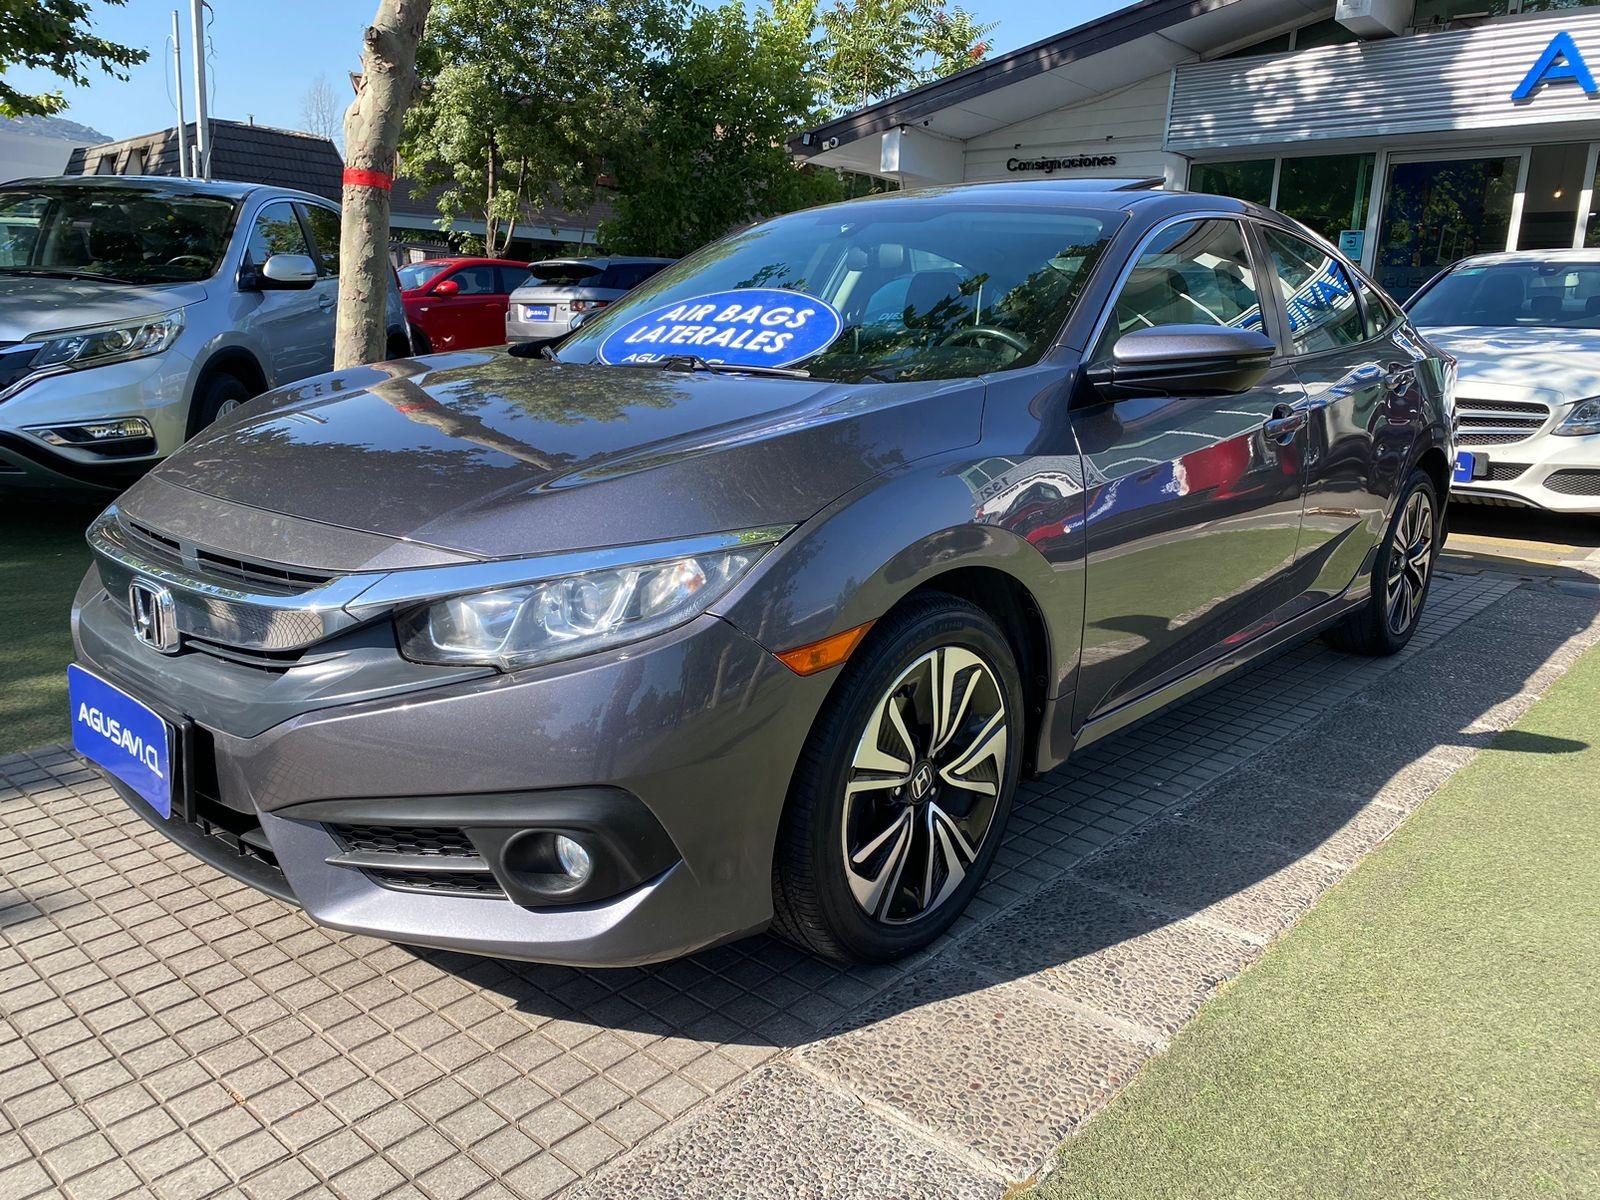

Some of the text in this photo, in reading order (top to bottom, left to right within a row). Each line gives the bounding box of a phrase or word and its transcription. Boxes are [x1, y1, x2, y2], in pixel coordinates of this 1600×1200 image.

[1006, 154, 1117, 174] Consignaciones
[656, 304, 815, 328] AIR BAGS
[624, 325, 794, 354] LATERALES
